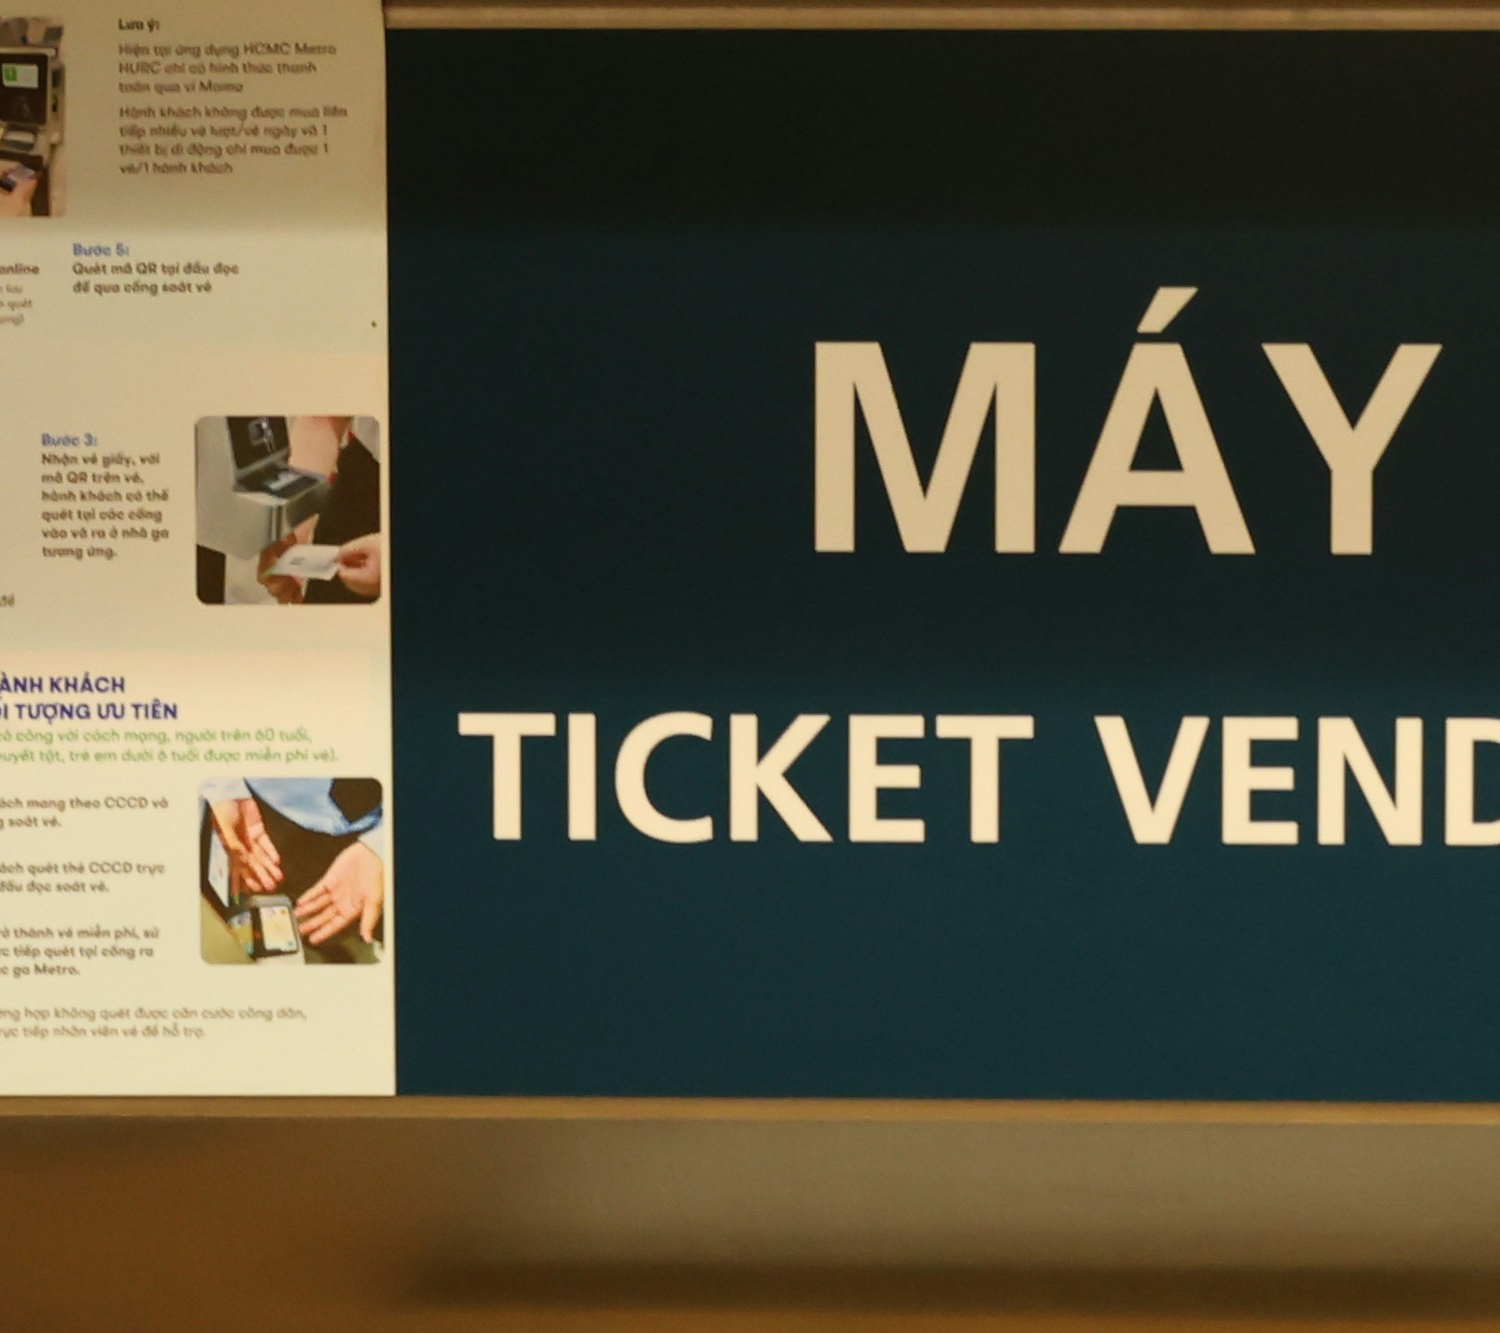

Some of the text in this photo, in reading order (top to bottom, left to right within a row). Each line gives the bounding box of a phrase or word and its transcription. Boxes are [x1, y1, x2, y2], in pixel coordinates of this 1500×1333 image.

[815, 287, 1442, 555] MÁY
[14, 703, 91, 724] TƯỢNG
[97, 702, 125, 720] ƯU
[131, 698, 177, 720] TIÊN
[458, 712, 1034, 843] TICKET
